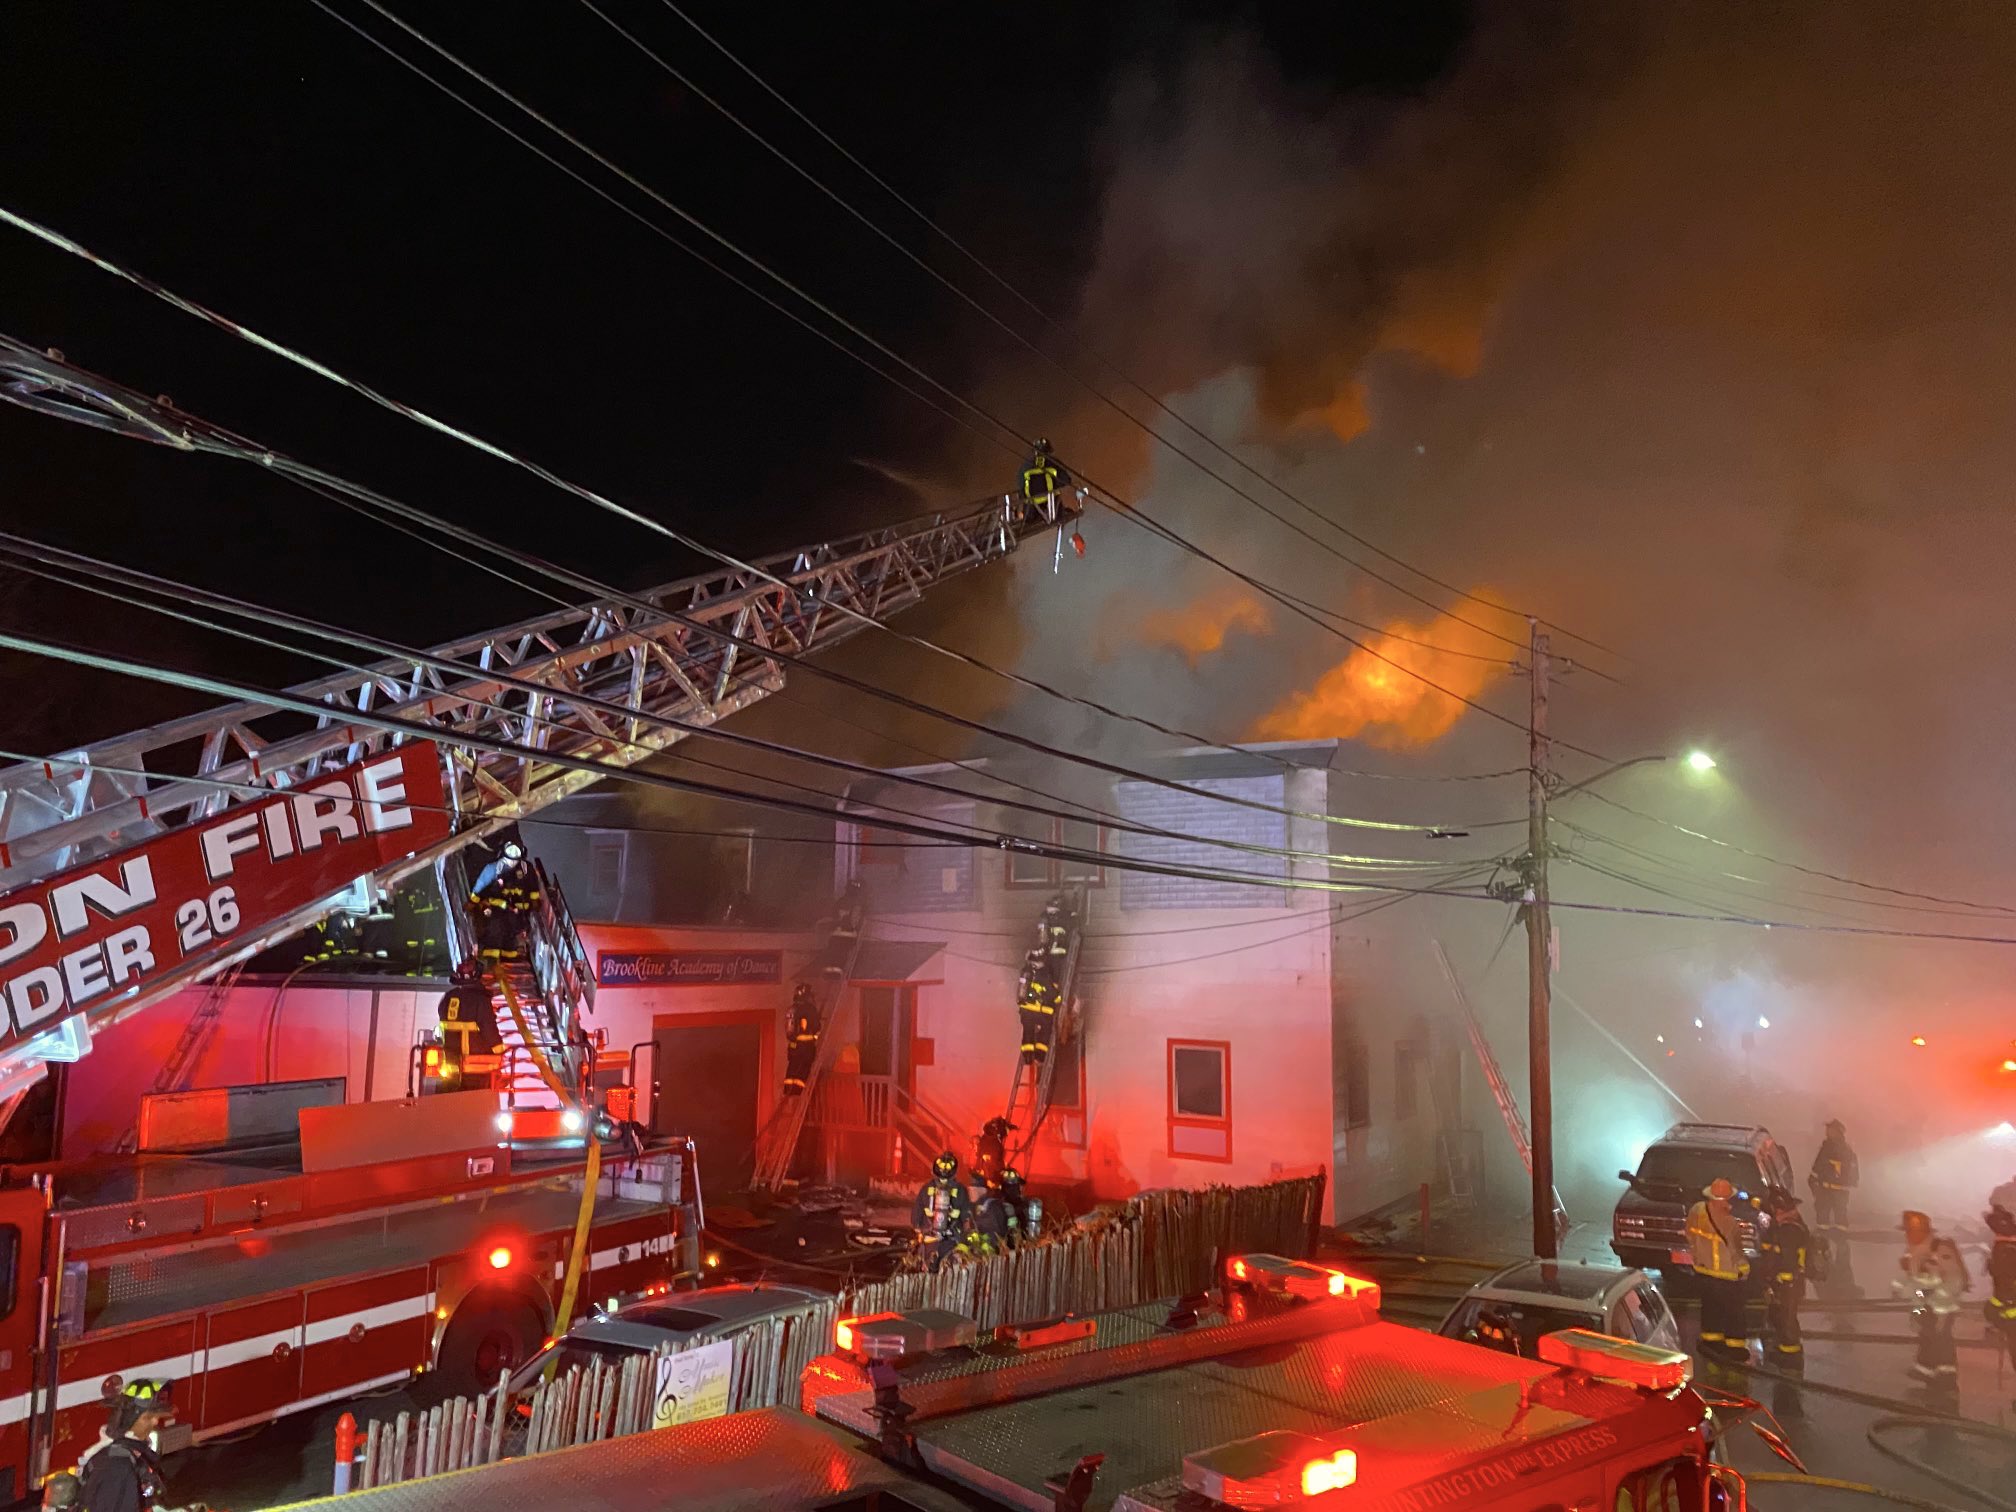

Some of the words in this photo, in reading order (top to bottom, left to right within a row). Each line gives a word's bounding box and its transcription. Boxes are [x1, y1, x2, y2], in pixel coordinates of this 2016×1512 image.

[201, 757, 413, 882] FIRE
[0, 925, 156, 1038] DER
[177, 885, 241, 956] 26
[603, 957, 665, 981] Brookline
[667, 956, 723, 981] Academy
[726, 956, 741, 980] of
[741, 958, 777, 975] Dance
[642, 1239, 659, 1257] 14
[1535, 1426, 1617, 1467] EXPRESS
